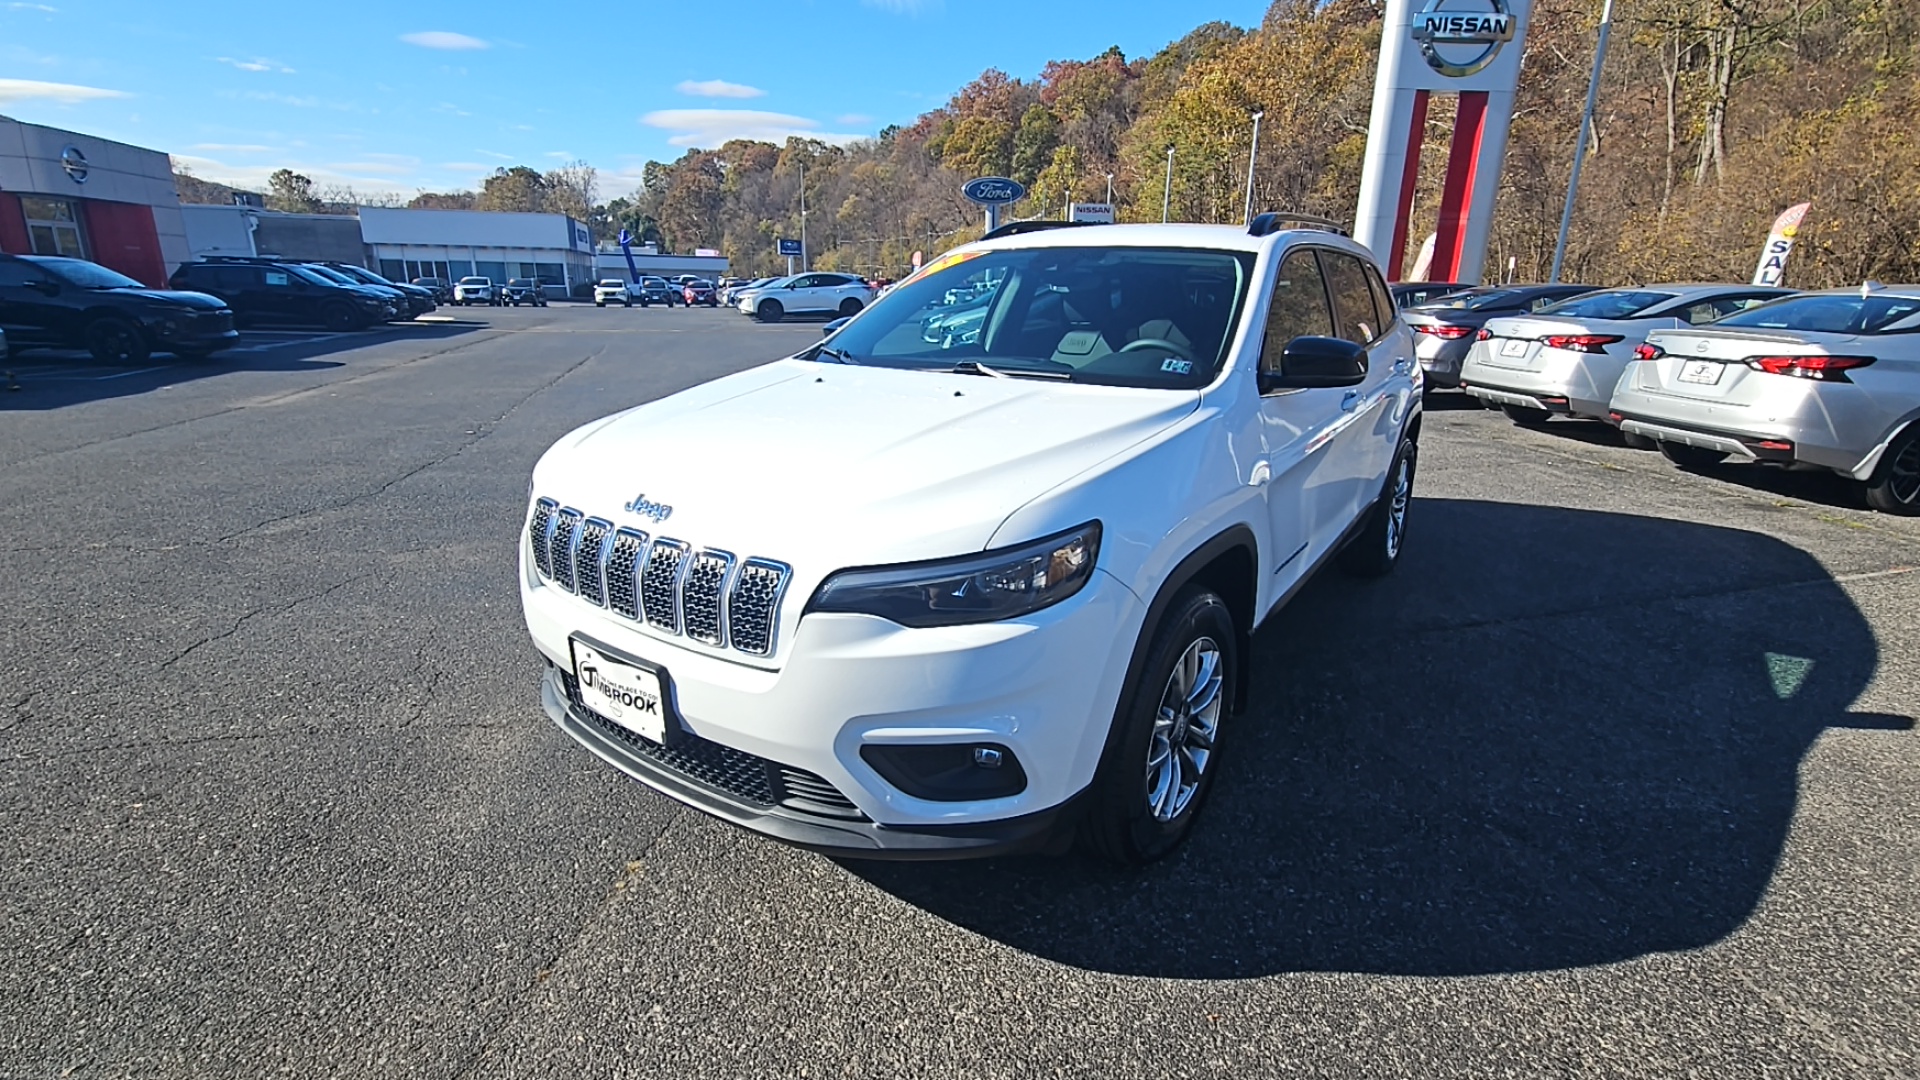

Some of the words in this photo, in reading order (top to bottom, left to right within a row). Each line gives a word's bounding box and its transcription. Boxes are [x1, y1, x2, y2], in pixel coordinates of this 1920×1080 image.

[1425, 17, 1508, 34] NISSAN
[977, 182, 1013, 199] Ford
[1076, 206, 1111, 214] NISSAN
[1760, 240, 1788, 284] SAL
[624, 493, 673, 524] Jeep
[580, 661, 657, 716] TIMBROOK
[618, 684, 638, 695] PLACE
